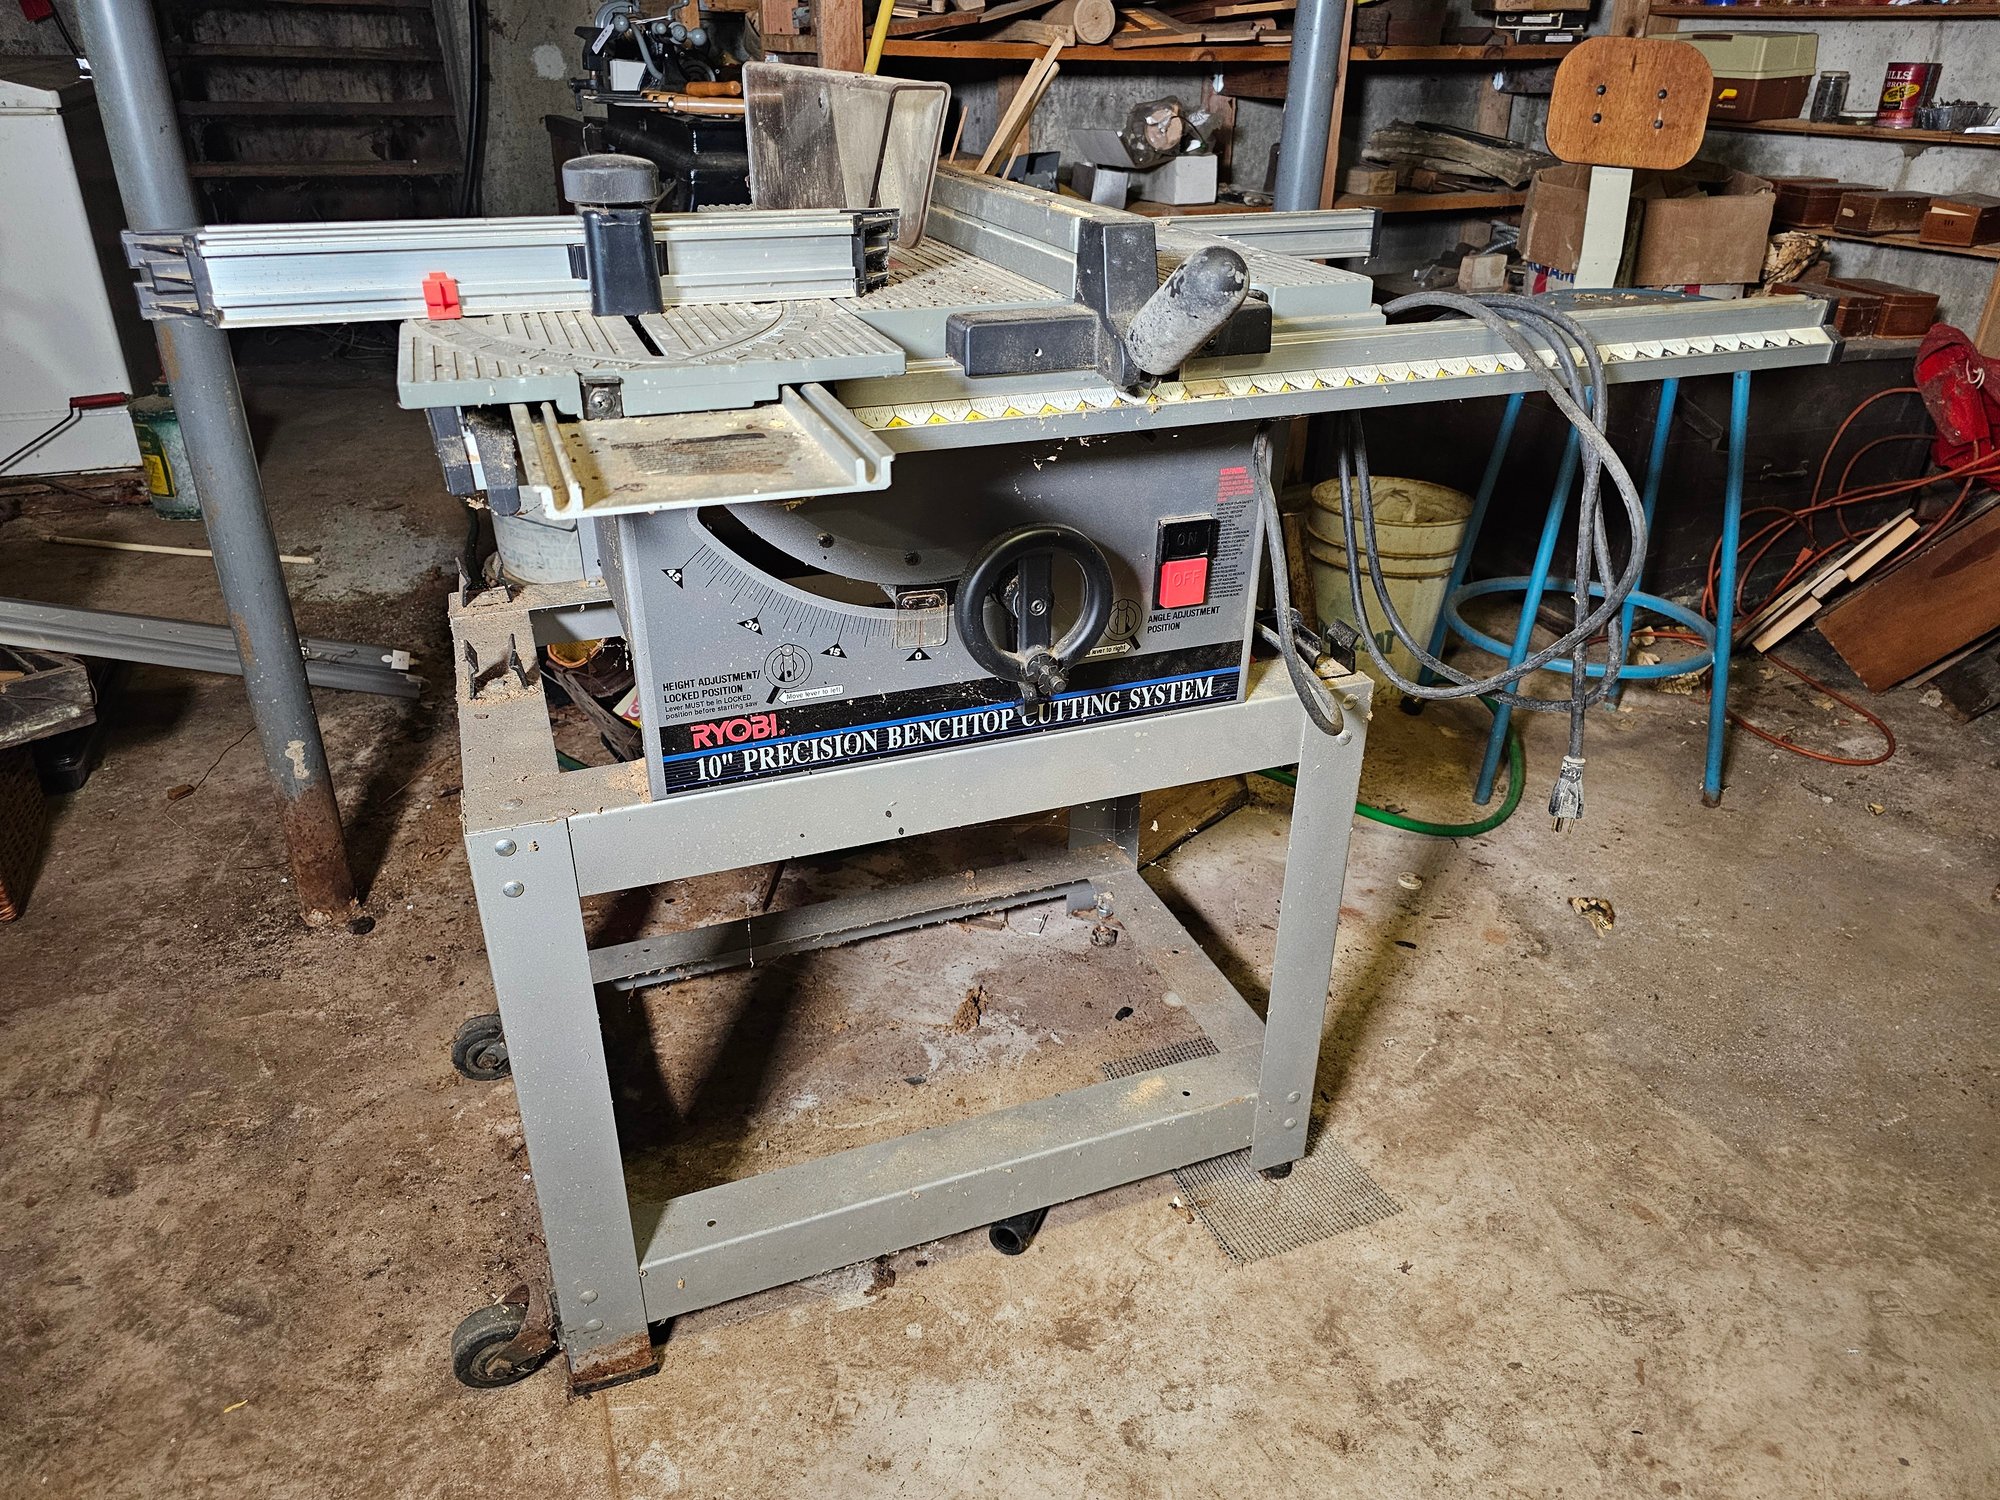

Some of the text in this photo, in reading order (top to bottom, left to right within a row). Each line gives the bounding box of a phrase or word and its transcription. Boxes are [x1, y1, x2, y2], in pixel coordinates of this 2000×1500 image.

[1177, 531, 1198, 545] ON
[667, 569, 682, 582] 45
[1172, 569, 1202, 588] OFF
[1147, 605, 1220, 623] ANGLE ADJUSTMENT
[744, 619, 759, 632] 30
[1147, 621, 1181, 634] POSITION
[829, 647, 841, 656] 15
[915, 652, 922, 660] 0
[662, 670, 760, 692] HEIGHT ADJUSTMENT/
[664, 685, 743, 704] LOCKED POSITION
[665, 704, 683, 712] Lever
[685, 701, 704, 710] MUST
[723, 694, 752, 703] LOCKED
[665, 711, 692, 720] position
[695, 706, 715, 715] before
[717, 702, 744, 711] starting
[690, 713, 777, 748] RYOBI
[696, 675, 1214, 781] 10" PRECISION BENCHTOP CUTTING SYSTEM
